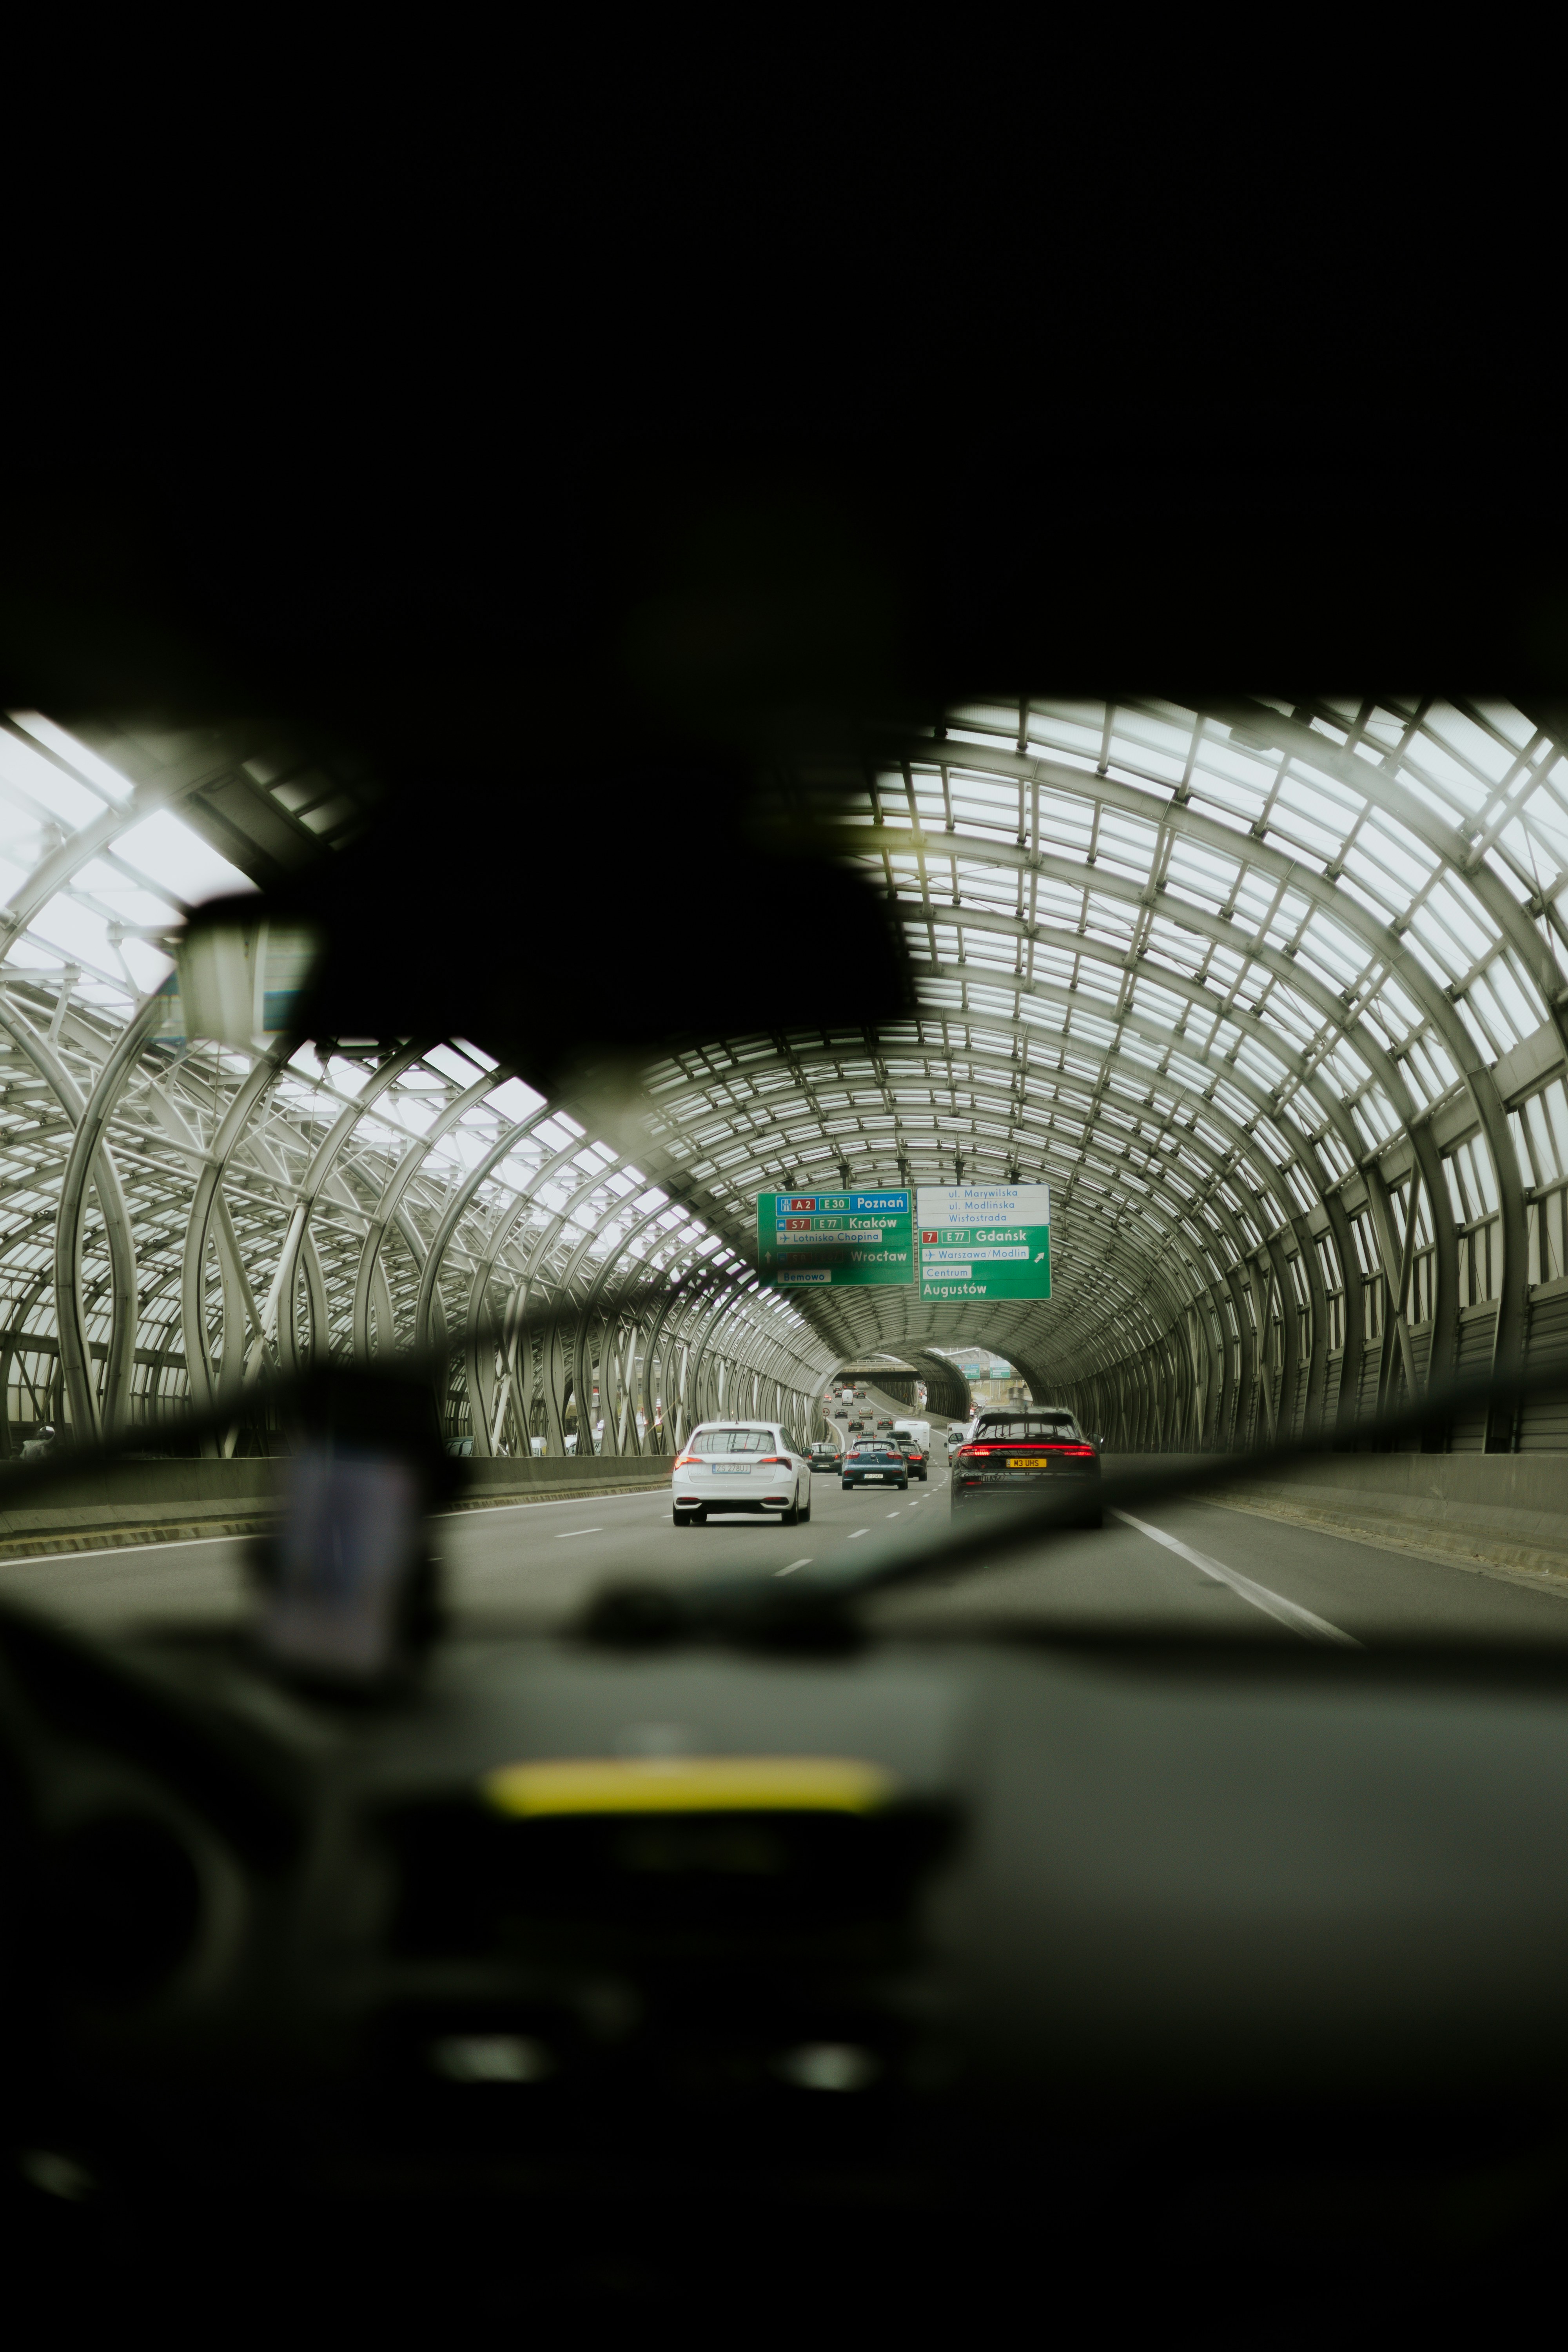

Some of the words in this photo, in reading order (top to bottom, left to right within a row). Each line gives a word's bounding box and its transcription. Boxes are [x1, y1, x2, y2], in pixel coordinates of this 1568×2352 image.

[965, 1189, 1018, 1199] Marywilska
[796, 1201, 803, 1209] A
[806, 1200, 811, 1209] 2
[832, 1200, 845, 1208] 30
[857, 1196, 904, 1209] Poznań
[965, 1201, 1015, 1210] Modlińska
[792, 1221, 797, 1229] S
[800, 1220, 805, 1229] 7
[849, 1217, 897, 1229] Kraków
[949, 1214, 1007, 1222] Wisłostrada
[793, 1233, 834, 1242] Lotnisko
[837, 1232, 879, 1243] Chopina
[927, 1233, 933, 1241] 7
[947, 1233, 952, 1241] E
[955, 1232, 965, 1241] 77
[976, 1230, 1027, 1241] Gdańsk
[851, 1250, 907, 1261] Wrocław
[938, 1249, 1026, 1259] Warszawa/Modlin
[923, 1283, 987, 1298] Augustów
